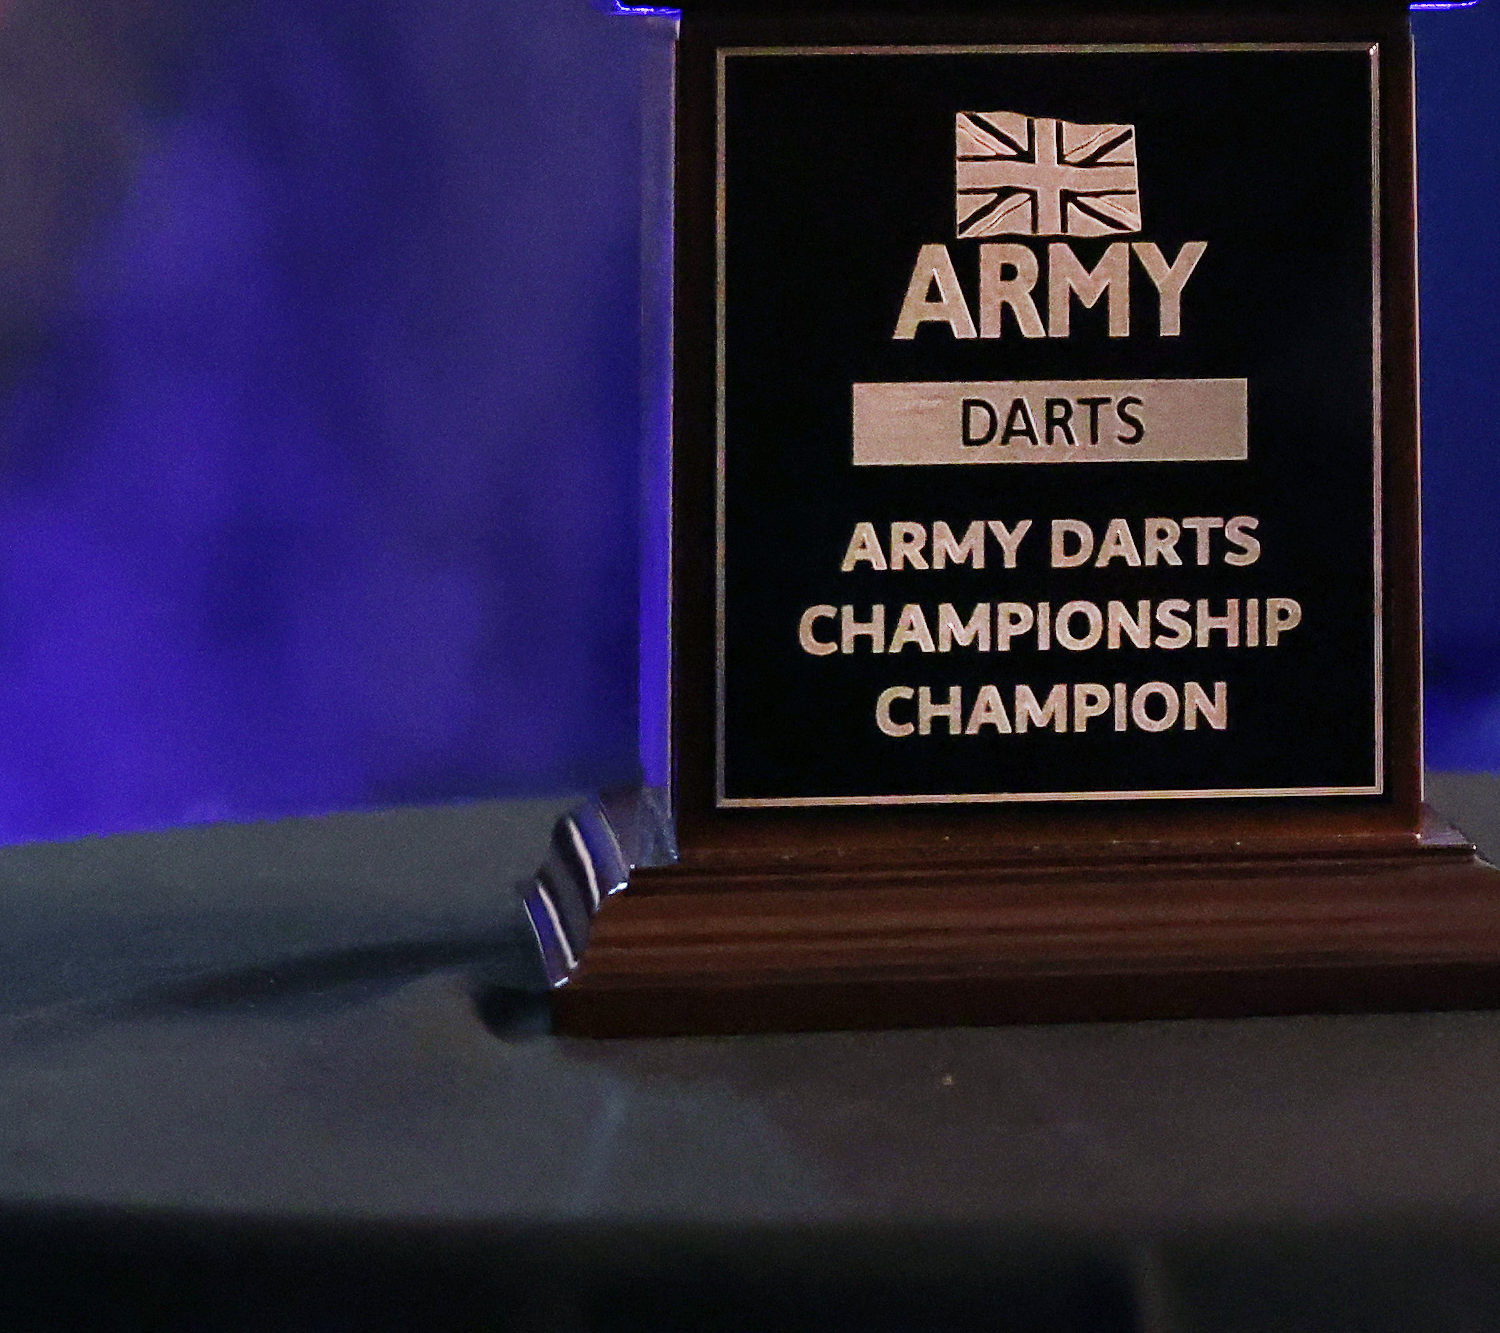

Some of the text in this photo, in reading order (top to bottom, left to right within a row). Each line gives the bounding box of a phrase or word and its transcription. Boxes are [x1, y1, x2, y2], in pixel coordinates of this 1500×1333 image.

[893, 241, 1208, 340] ARMY
[961, 396, 1146, 448] DARTS
[841, 516, 1261, 572] ARMY DARTS
[798, 597, 1302, 656] CHAMPIONSHIP
[875, 680, 1228, 738] CHAMPION
